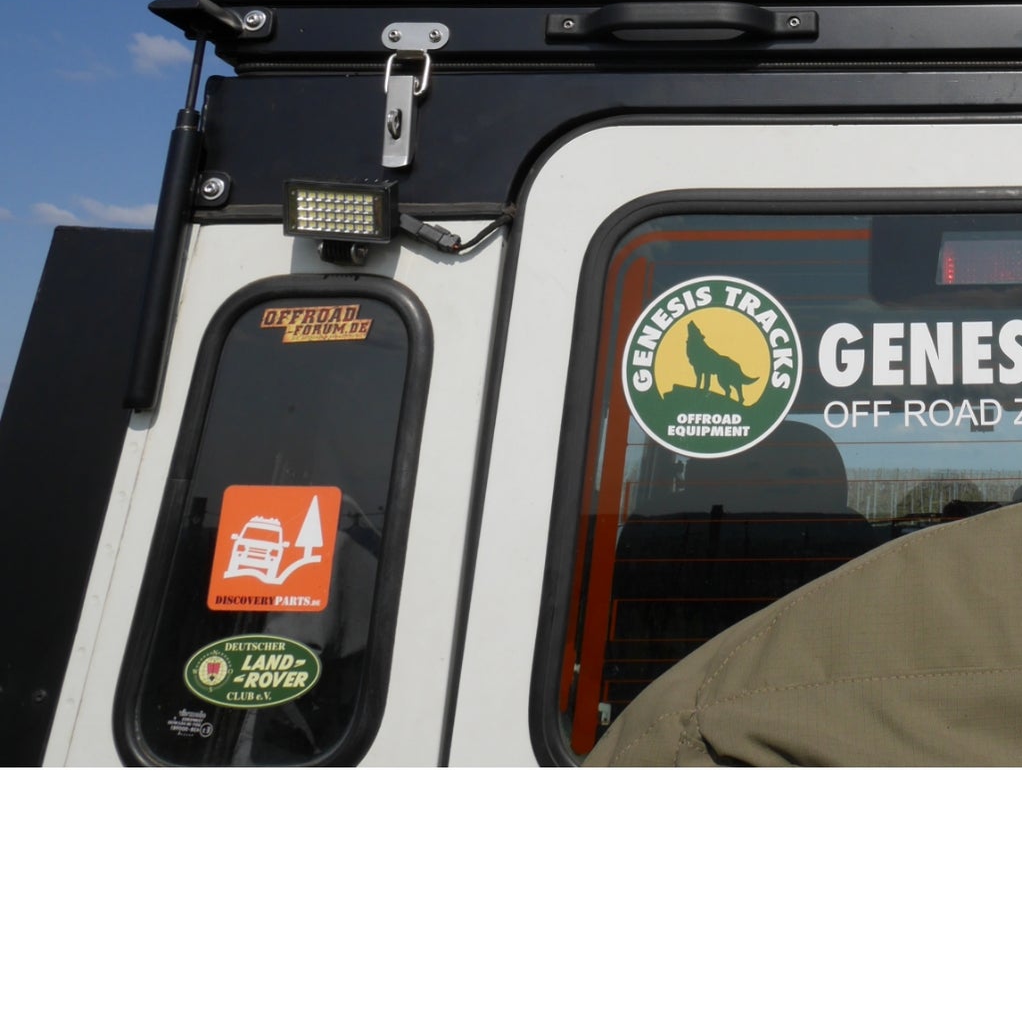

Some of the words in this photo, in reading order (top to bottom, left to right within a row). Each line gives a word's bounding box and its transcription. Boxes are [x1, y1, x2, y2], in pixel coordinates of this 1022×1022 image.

[264, 307, 357, 325] OFFROAD
[632, 286, 712, 392] GENESIS
[725, 286, 793, 389] TRACKS
[677, 413, 742, 425] OFFROAD
[823, 400, 892, 428] OFF
[904, 398, 1003, 427] ROAD
[667, 425, 750, 437] EQUIPMENT
[224, 642, 286, 651] DEUTSCHER
[226, 691, 255, 701] CLUB
